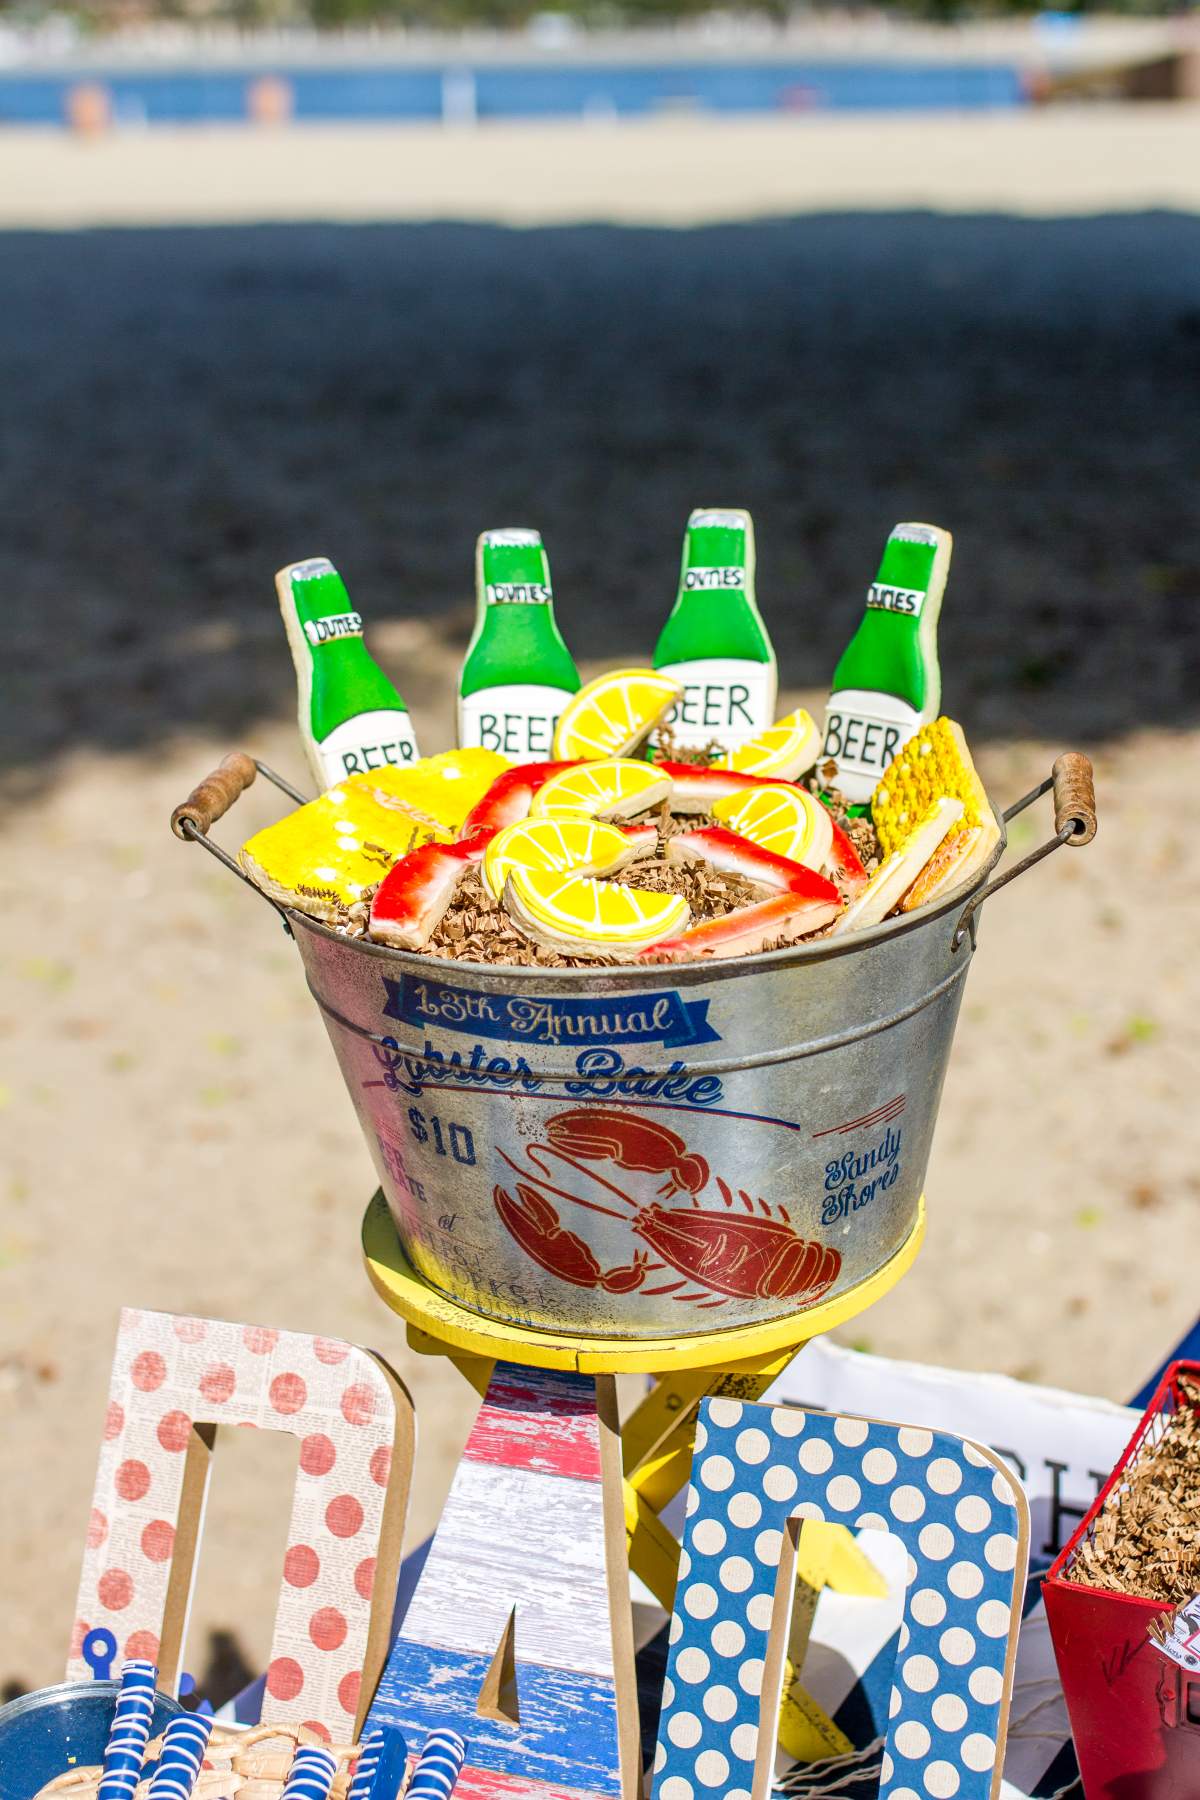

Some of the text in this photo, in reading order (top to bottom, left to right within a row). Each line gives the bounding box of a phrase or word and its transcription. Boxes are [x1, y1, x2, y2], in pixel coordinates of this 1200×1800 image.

[494, 585, 551, 601] DUNES
[480, 714, 560, 752] BEE
[414, 984, 674, 1042] 13th Annual
[372, 1035, 725, 1106] Lobster Bake
[408, 1106, 477, 1167] $10
[824, 1128, 902, 1190] Sandy
[821, 1164, 900, 1227] Shores
